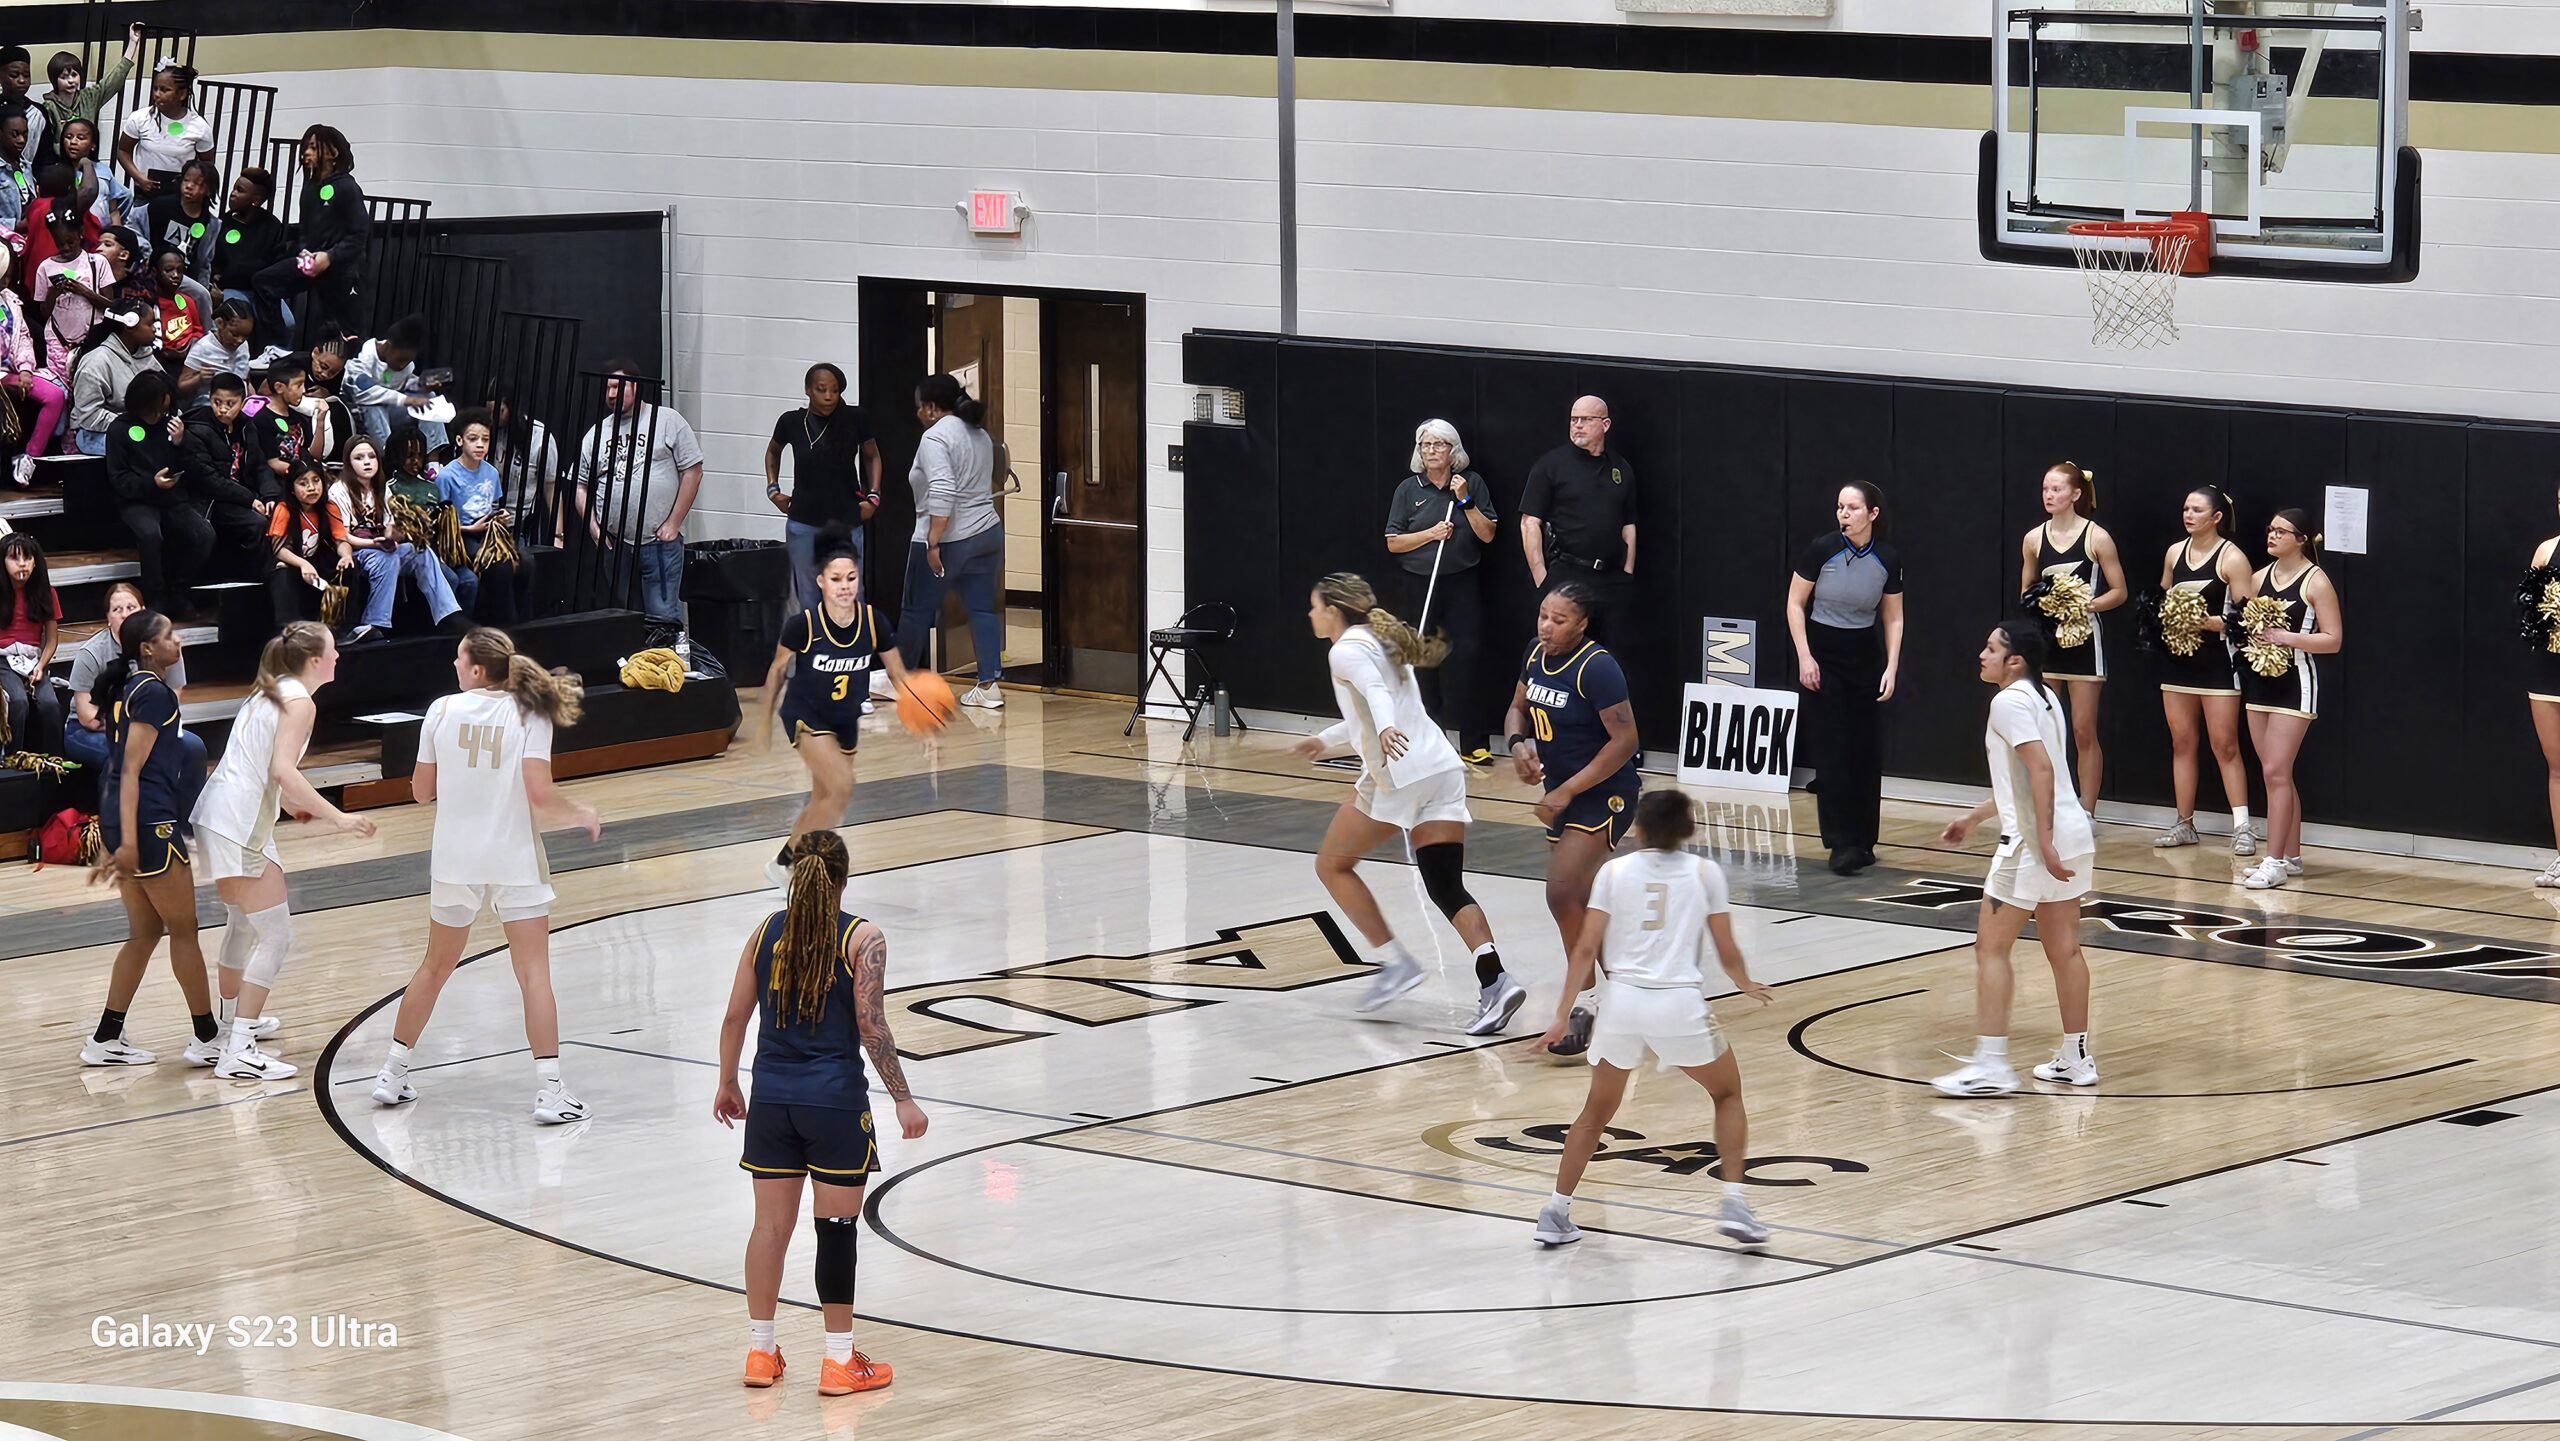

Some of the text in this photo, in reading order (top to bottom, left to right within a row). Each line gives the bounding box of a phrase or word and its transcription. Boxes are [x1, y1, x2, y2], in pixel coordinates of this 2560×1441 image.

[974, 193, 1007, 228] EXIT
[831, 674, 849, 701] 3
[458, 723, 504, 770] 44
[1529, 706, 1553, 742] 10
[1683, 700, 1795, 777] BLACK
[1641, 882, 1668, 931] 3
[1474, 1123, 1870, 1187] SAC
